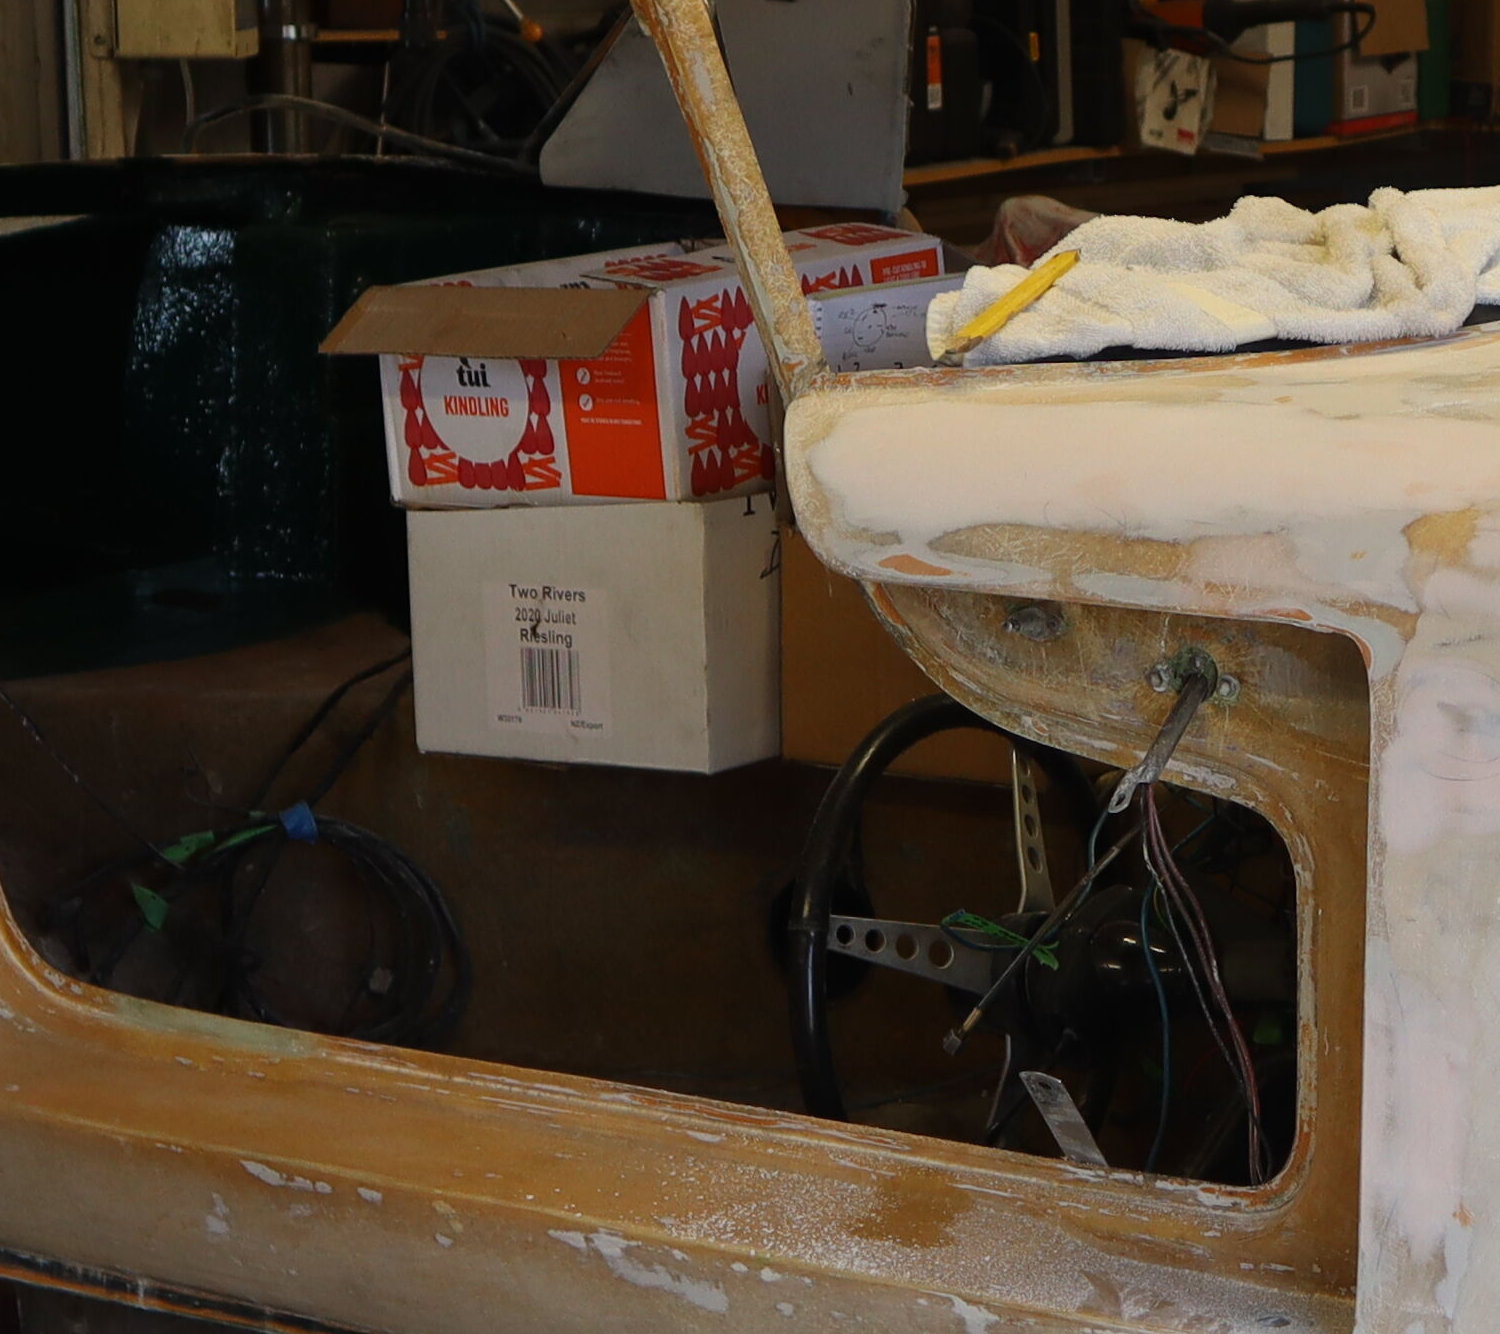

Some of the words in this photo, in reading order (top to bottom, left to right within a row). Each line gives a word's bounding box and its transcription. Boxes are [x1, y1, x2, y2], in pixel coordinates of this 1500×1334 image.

[444, 394, 510, 417] KINDLING
[508, 583, 539, 600] Two
[542, 585, 586, 603] Rivers
[514, 606, 541, 623] 2020
[544, 608, 577, 626] Juliet
[519, 627, 573, 649] Riesling
